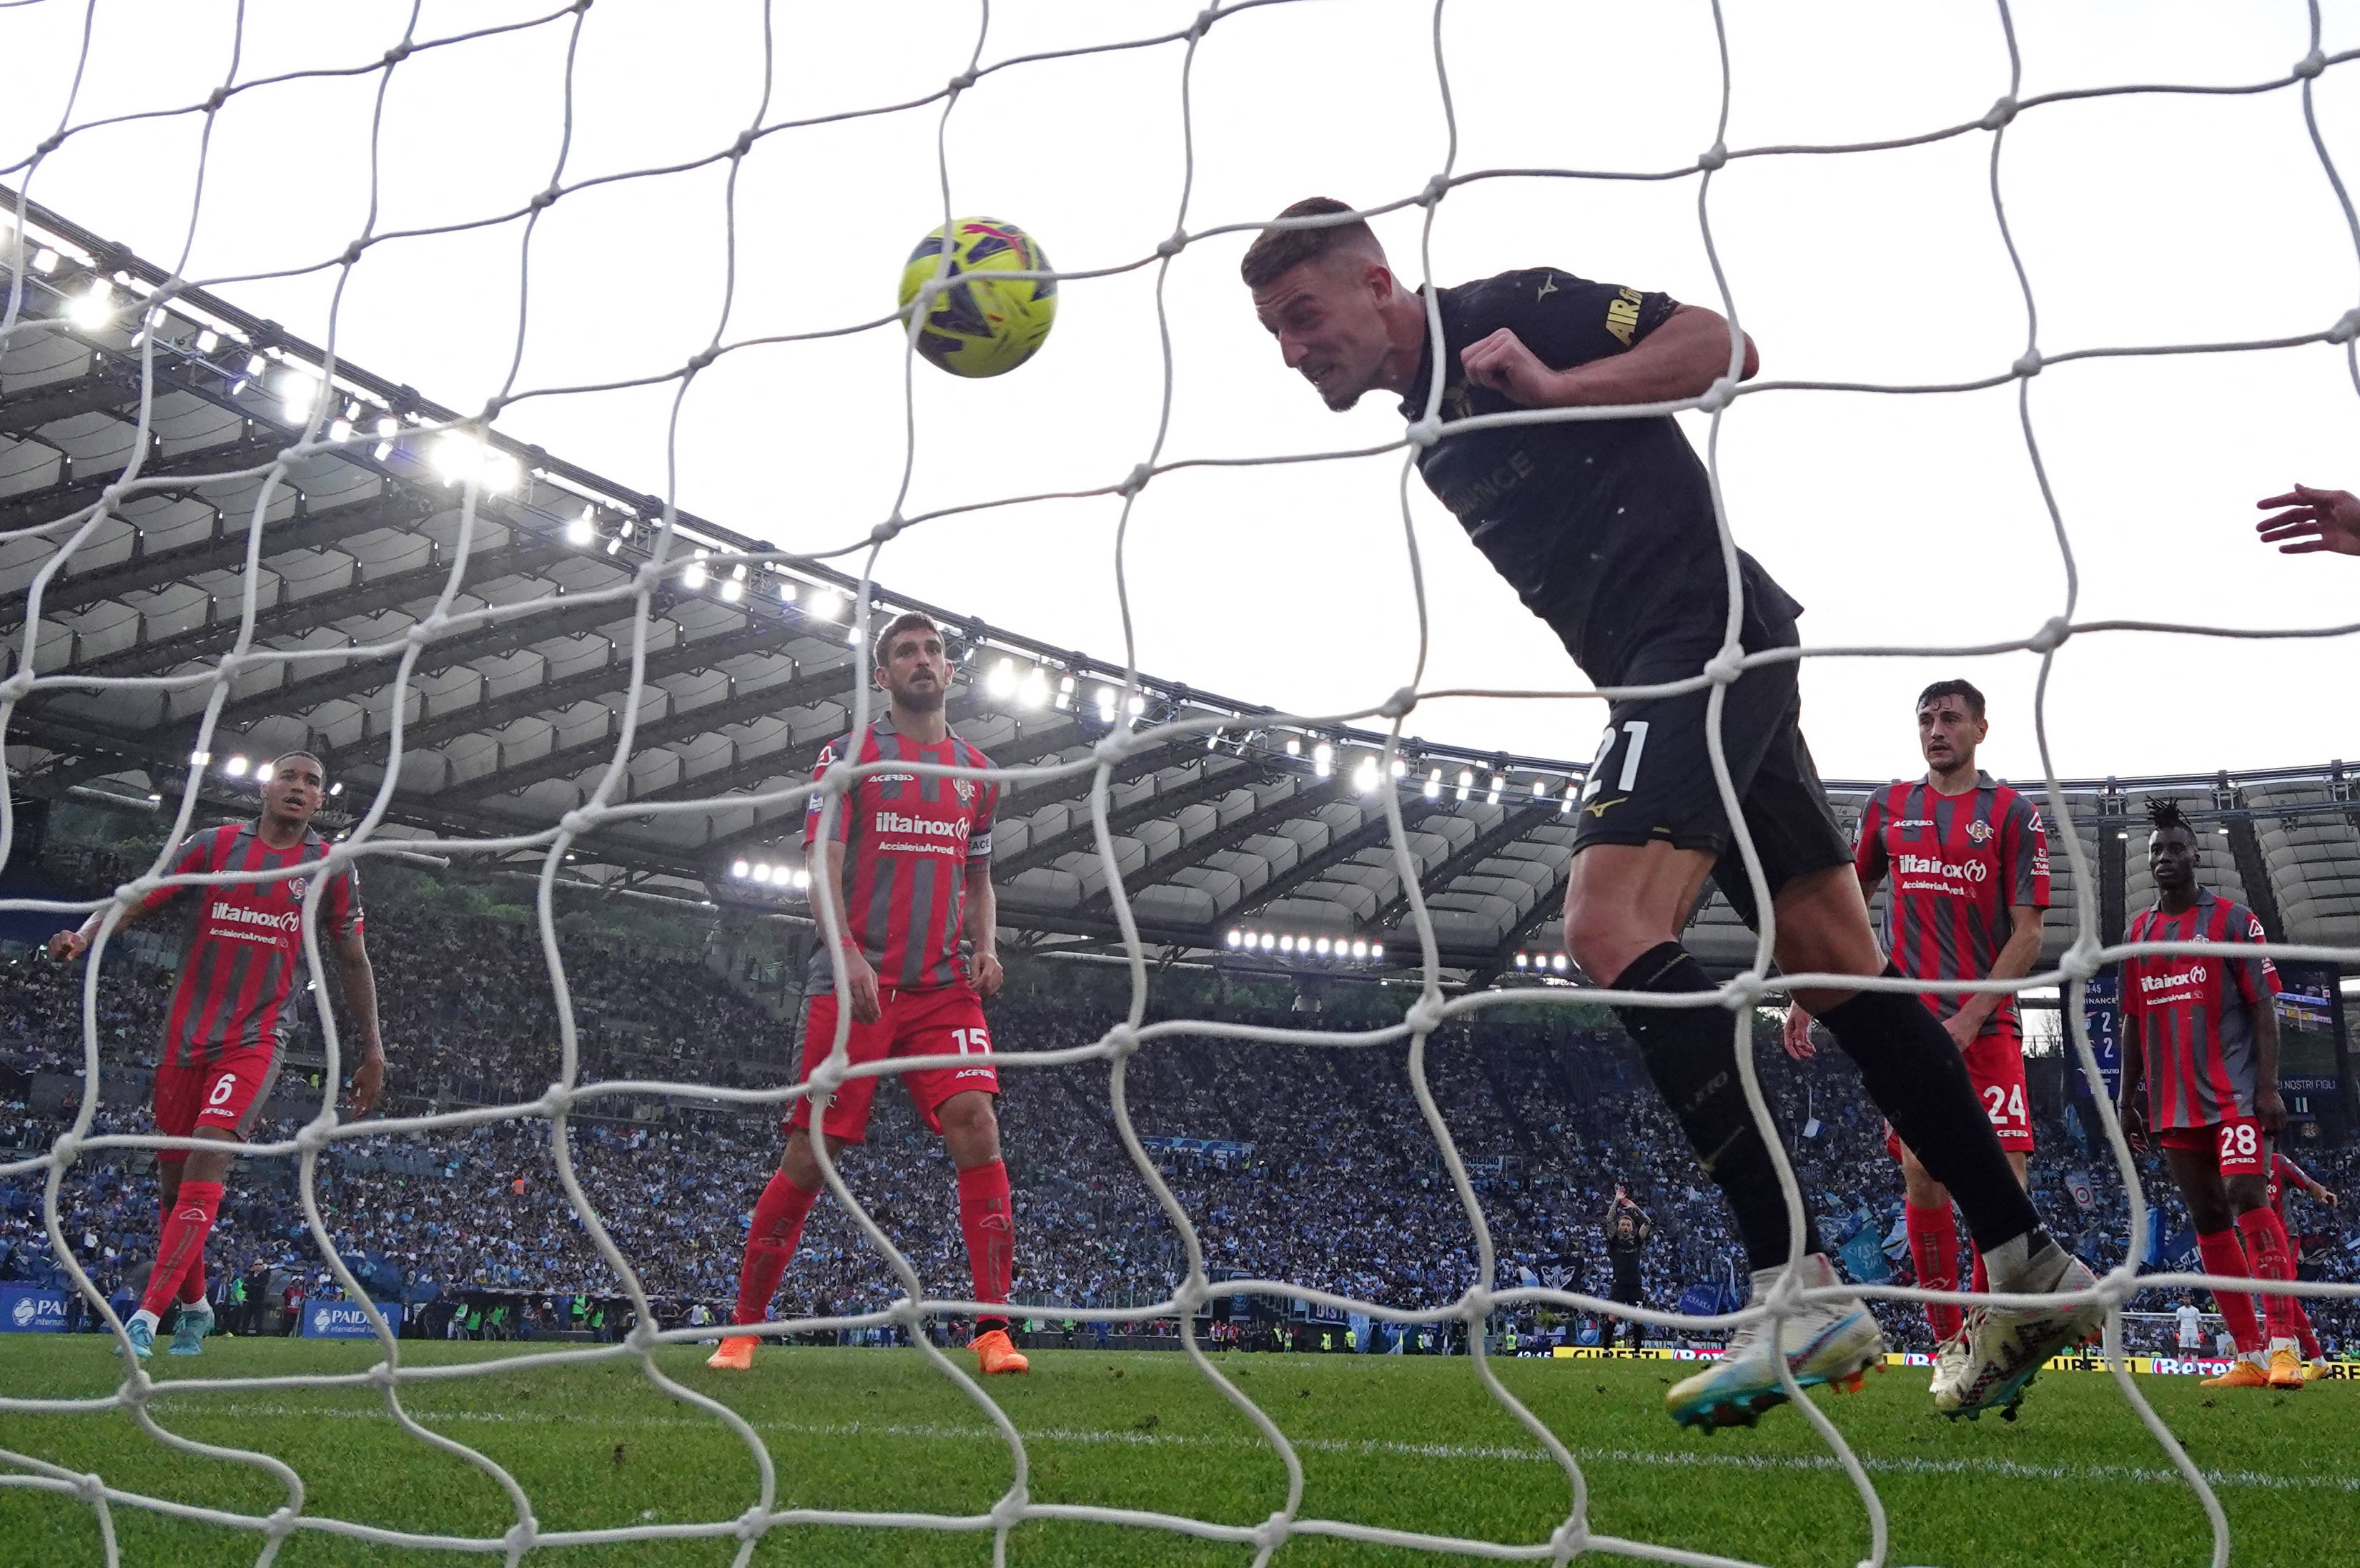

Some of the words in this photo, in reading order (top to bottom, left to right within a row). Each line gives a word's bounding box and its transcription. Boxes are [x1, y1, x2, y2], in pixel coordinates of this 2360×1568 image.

[1581, 721, 1649, 802] 21
[876, 812, 955, 837] iltainox
[212, 902, 280, 928] iltainox
[2085, 984, 2101, 994] 9:45
[2101, 1012, 2111, 1032] 2
[952, 1027, 990, 1056] 15
[2103, 1037, 2113, 1058] 2
[209, 1073, 237, 1105] 6
[1983, 1084, 2026, 1125] 24
[2221, 1124, 2257, 1158] 28
[332, 1310, 390, 1325] PAIDA
